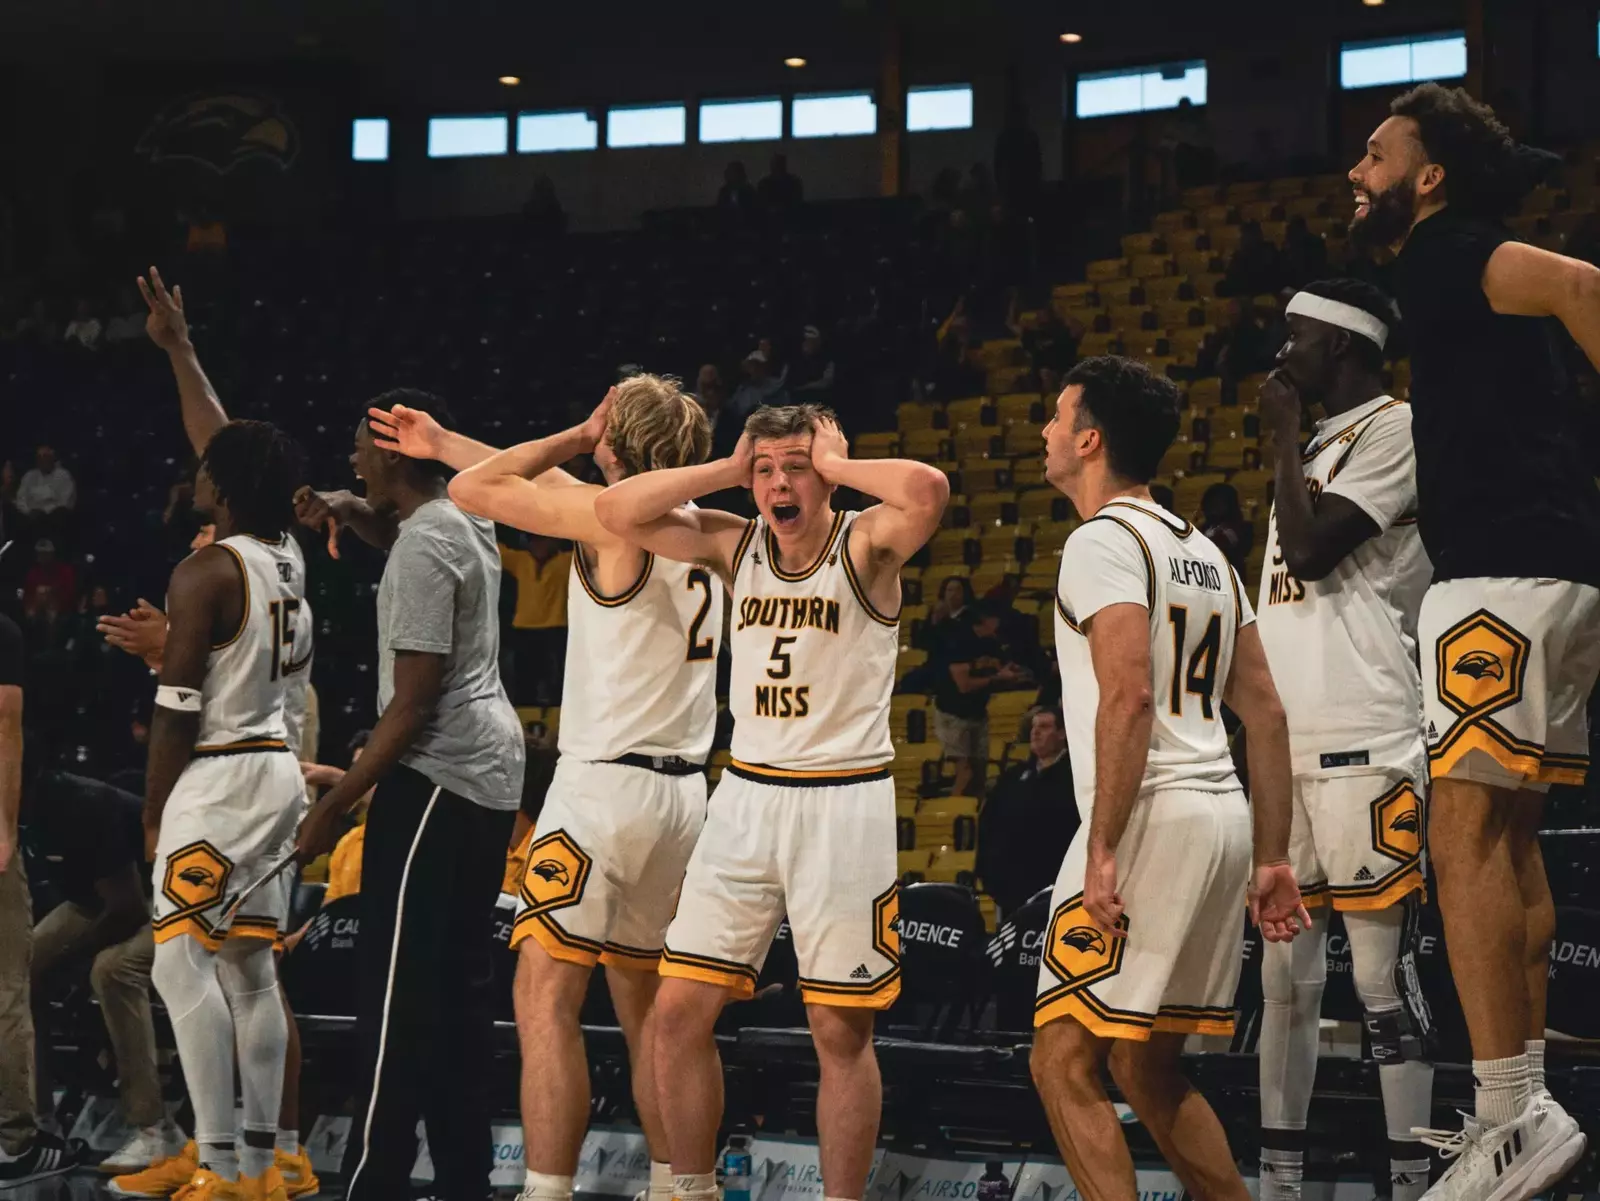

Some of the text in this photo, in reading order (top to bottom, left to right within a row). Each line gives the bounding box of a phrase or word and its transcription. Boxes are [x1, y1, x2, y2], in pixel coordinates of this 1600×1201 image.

[1268, 571, 1306, 606] MISS
[685, 568, 715, 662] 2
[737, 596, 840, 635] SOUTHRN
[268, 598, 313, 682] 15
[766, 636, 798, 680] 5
[1168, 603, 1221, 721] 14
[755, 684, 810, 718] MISS
